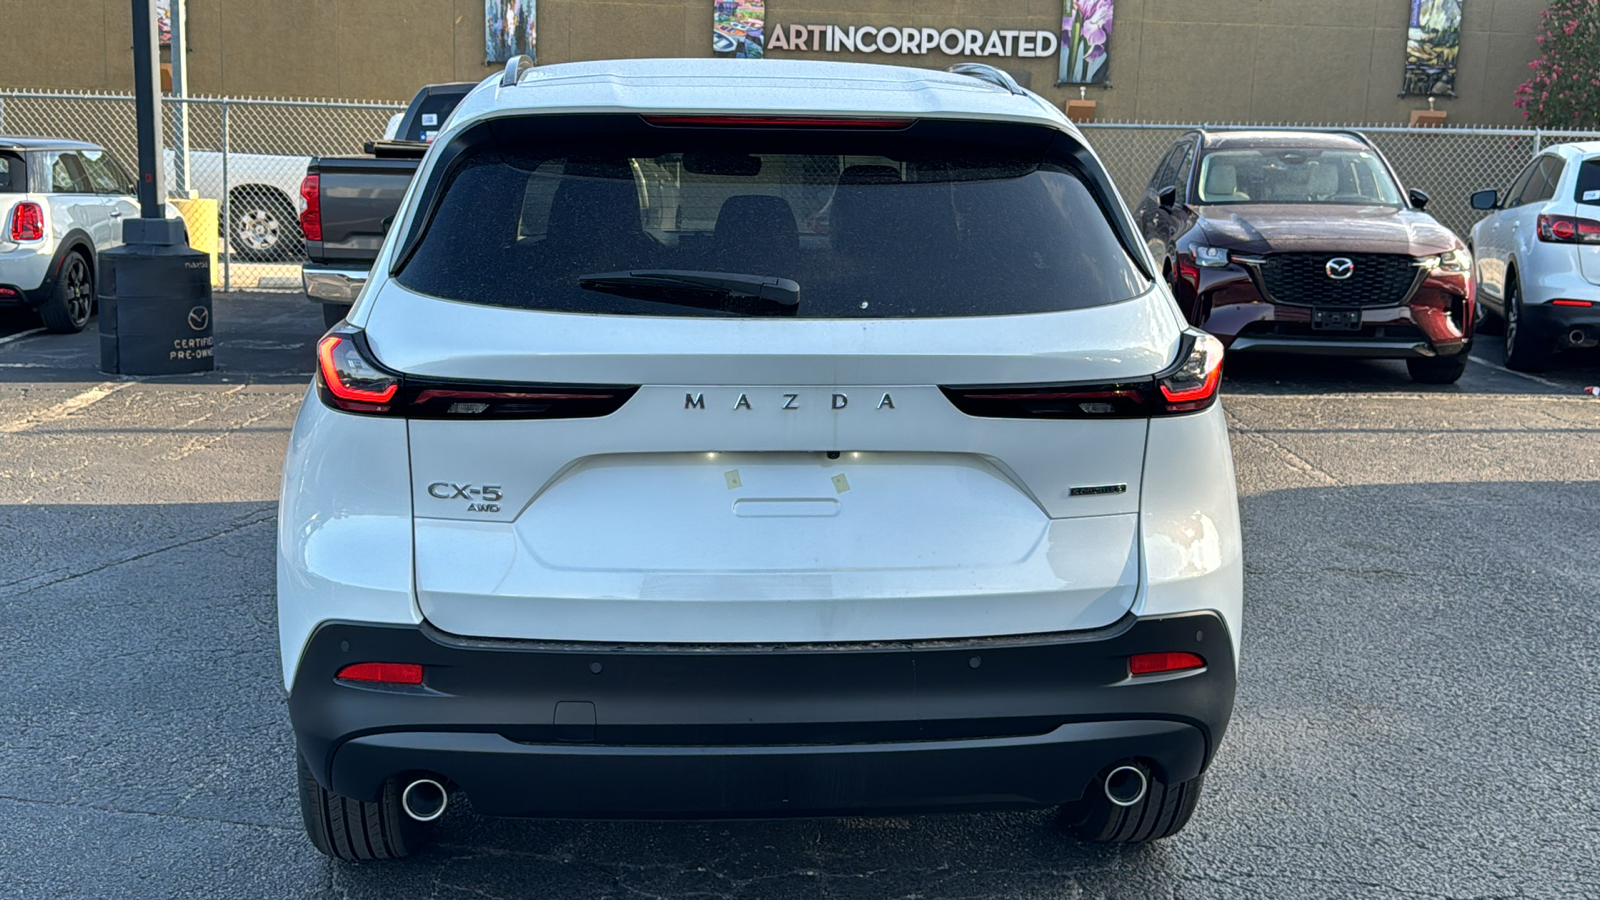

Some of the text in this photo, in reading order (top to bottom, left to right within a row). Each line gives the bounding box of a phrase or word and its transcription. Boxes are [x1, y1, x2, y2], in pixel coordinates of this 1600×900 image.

[767, 23, 1058, 58] ARTINCORPORATED
[684, 392, 895, 410] MAZDA
[427, 482, 503, 501] CX-5
[467, 503, 501, 512] AWD
